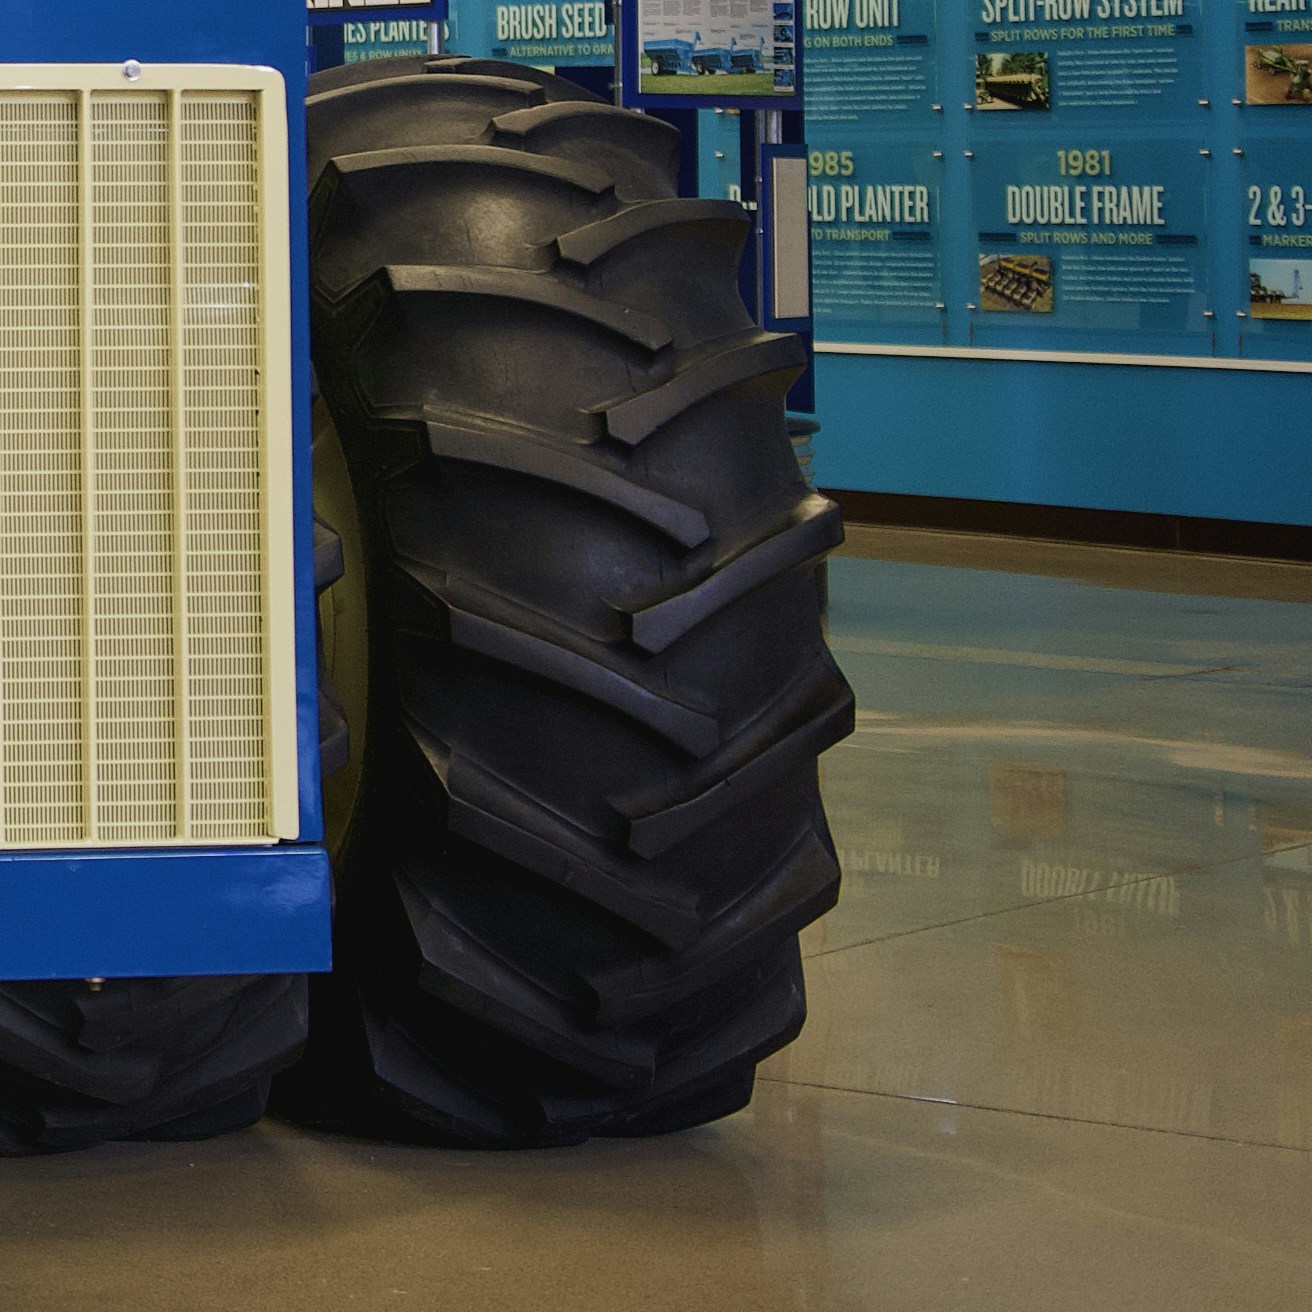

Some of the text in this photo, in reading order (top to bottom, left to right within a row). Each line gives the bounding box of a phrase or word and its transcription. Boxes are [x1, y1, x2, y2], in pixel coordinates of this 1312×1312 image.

[497, 3, 557, 41] BRUSH
[561, 2, 607, 38] SEED
[991, 24, 1175, 42] SPLIT ROWS FOR THE FIRST TIME
[510, 44, 575, 57] ALTERNATIVE
[578, 44, 591, 55] TO
[814, 36, 831, 48] ON
[833, 36, 862, 48] BOTH
[864, 34, 894, 46] ENDS
[809, 150, 854, 176] 985
[1057, 149, 1111, 176] 1981
[809, 184, 929, 223] LD PLANTER
[1007, 185, 1165, 225] DOUBLE FRAME
[1249, 185, 1261, 225] 2
[1267, 185, 1287, 226] &
[825, 229, 890, 241] TRANSPORT
[1019, 231, 1153, 245] SPLIT ROWS AND MORE
